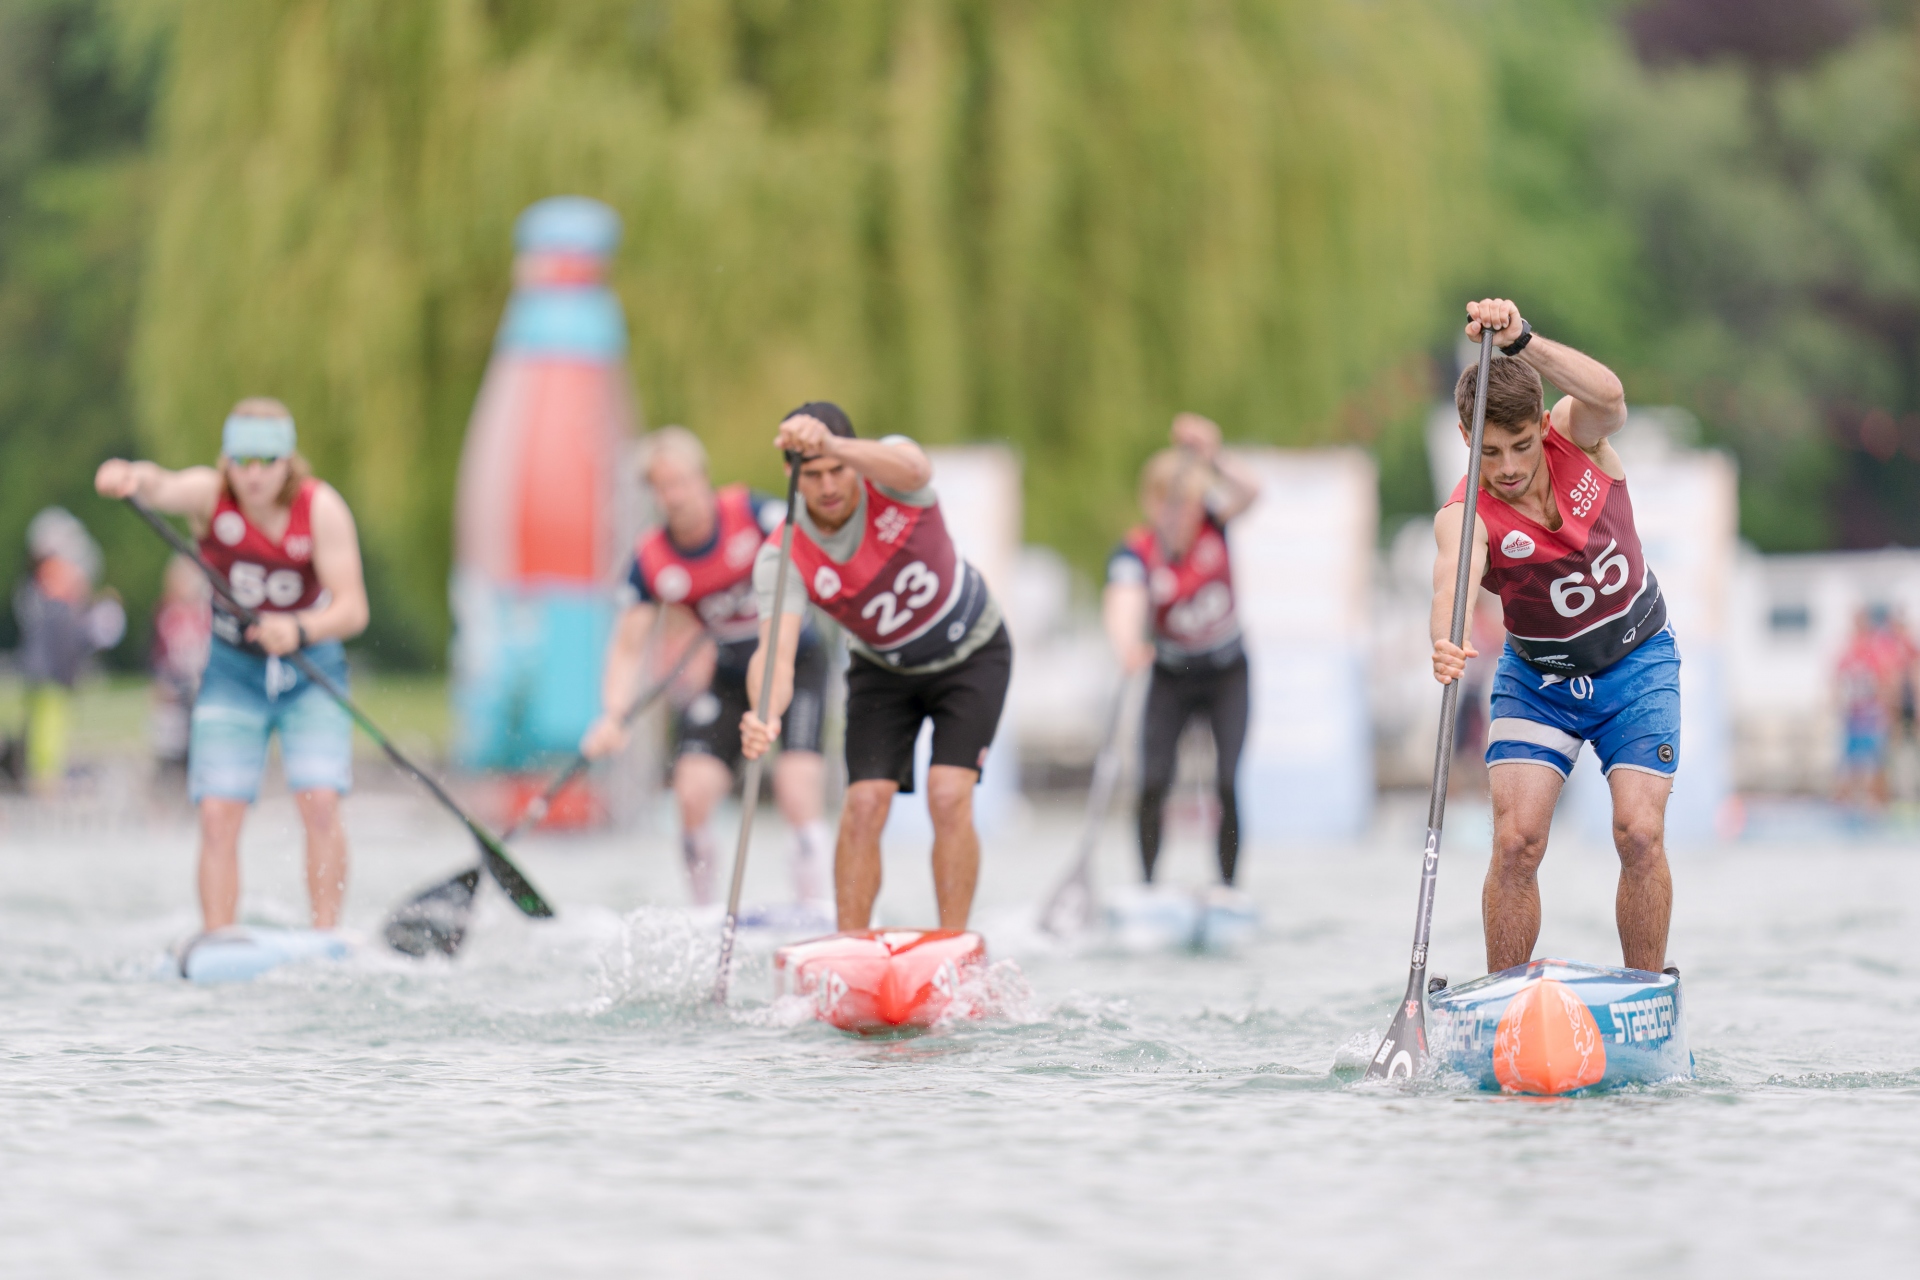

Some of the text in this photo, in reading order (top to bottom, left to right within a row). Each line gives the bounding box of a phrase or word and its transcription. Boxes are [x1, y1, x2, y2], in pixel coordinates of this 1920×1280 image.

[1570, 468, 1592, 502] SUP
[861, 561, 939, 636] 23
[1550, 538, 1629, 618] 65
[1412, 950, 1425, 963] 81
